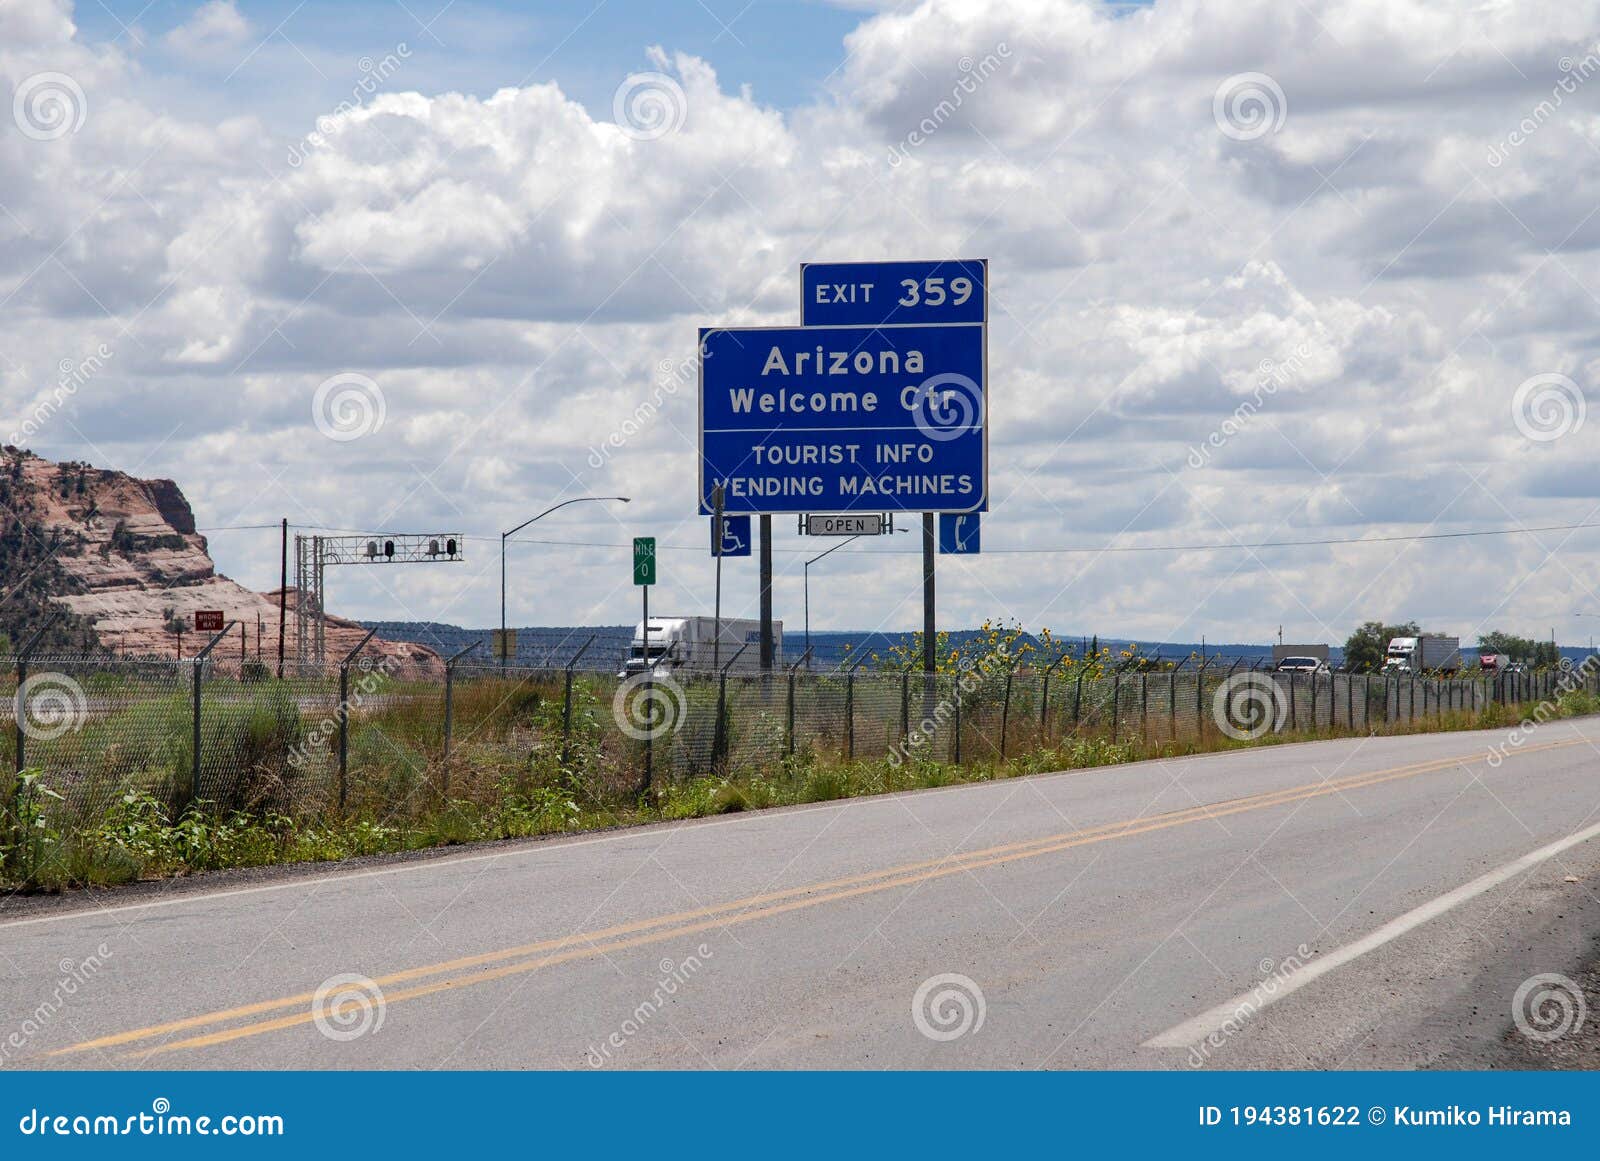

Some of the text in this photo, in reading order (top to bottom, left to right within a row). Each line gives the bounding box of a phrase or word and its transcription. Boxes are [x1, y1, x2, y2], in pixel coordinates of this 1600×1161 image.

[816, 277, 973, 307] EXIT 359
[761, 346, 924, 376] Arizona
[729, 386, 956, 413] Welcome Ctr
[752, 444, 934, 465] TOURIST INFO
[840, 475, 973, 495] MACHINES
[825, 519, 865, 532] OPEN
[635, 543, 654, 556] MILE
[641, 563, 649, 577] 0
